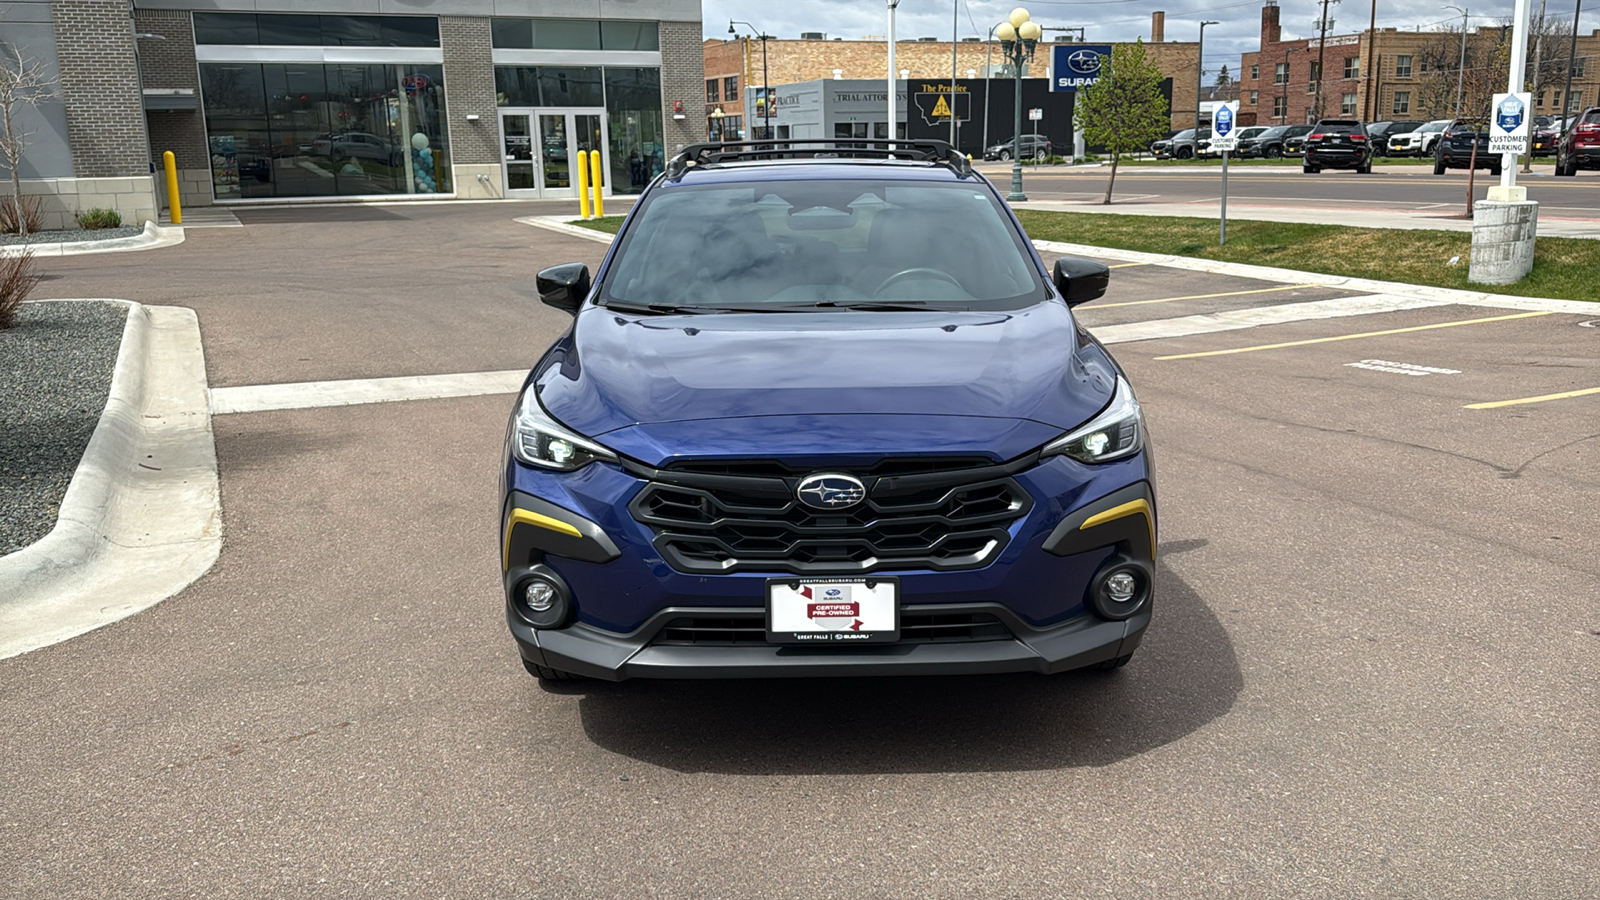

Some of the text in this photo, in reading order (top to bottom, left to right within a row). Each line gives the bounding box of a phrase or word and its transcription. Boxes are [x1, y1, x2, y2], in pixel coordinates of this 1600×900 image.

[1058, 78, 1101, 87] SUBAR
[921, 84, 936, 92] The
[777, 95, 800, 106] PRACTICE
